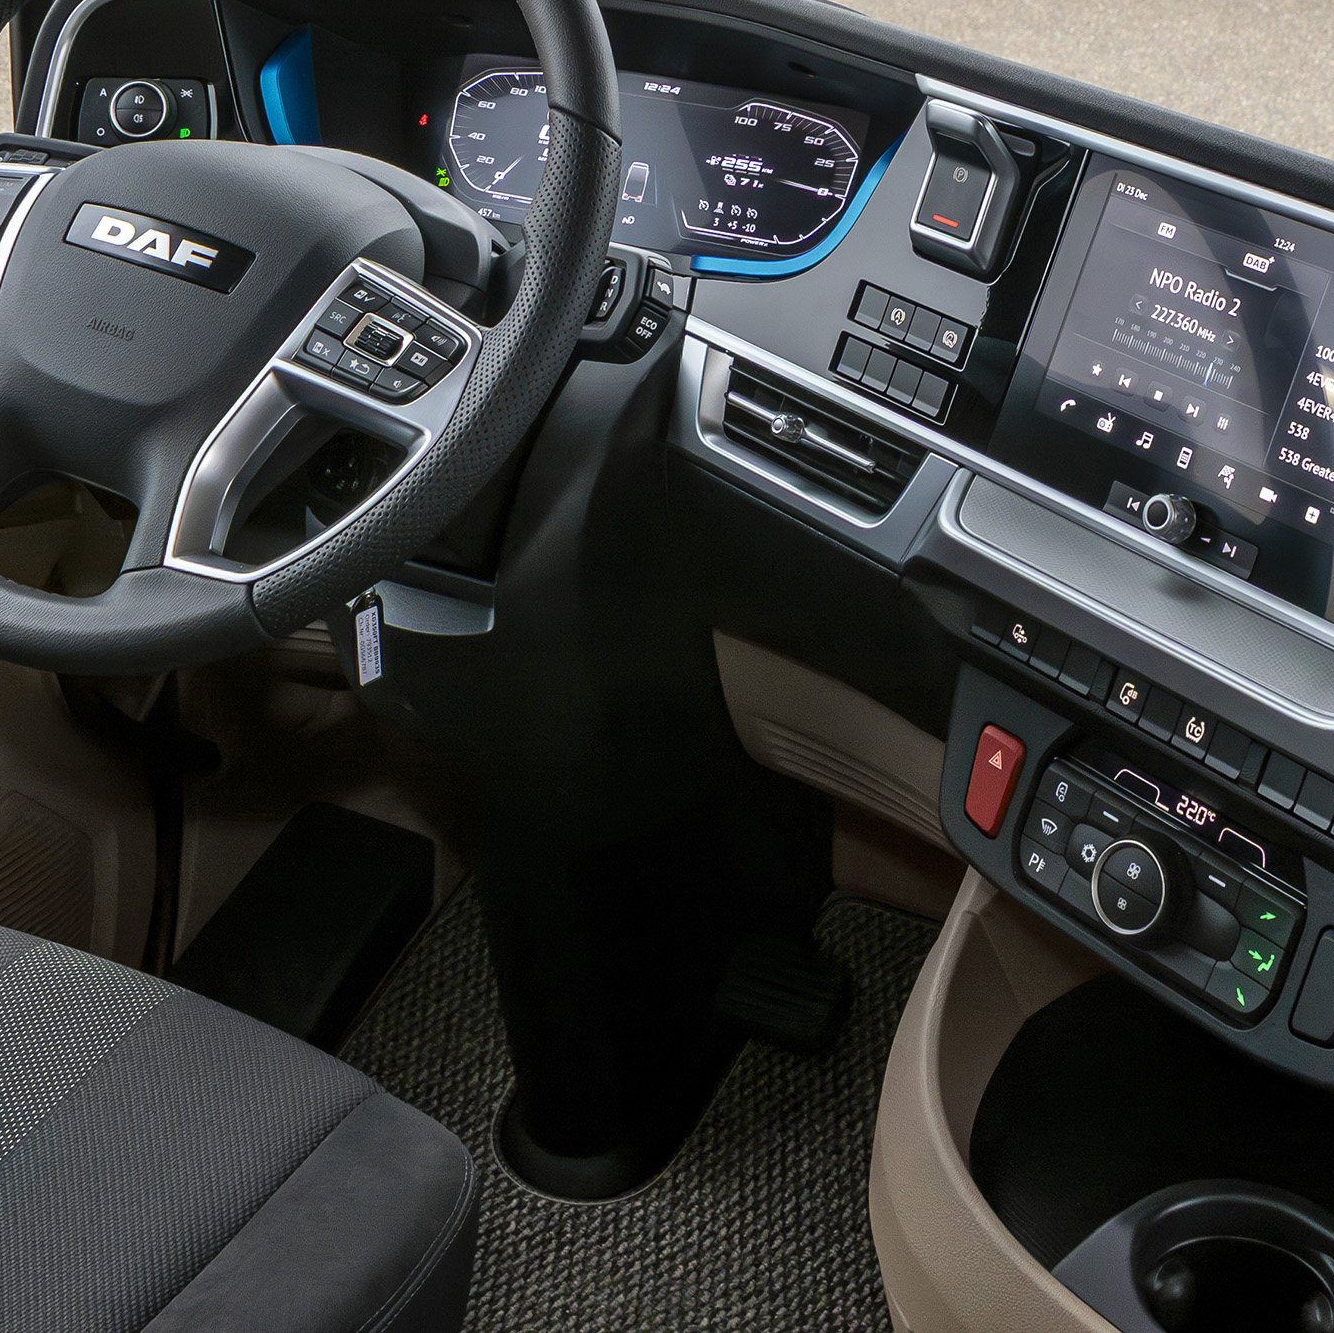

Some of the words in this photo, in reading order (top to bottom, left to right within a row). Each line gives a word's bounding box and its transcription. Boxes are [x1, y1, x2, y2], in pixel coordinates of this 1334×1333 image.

[99, 87, 108, 97] A
[509, 87, 528, 97] 80
[643, 82, 681, 95] 12:24
[477, 100, 496, 110] 60
[734, 116, 758, 127] 100
[773, 122, 793, 132] 75
[468, 132, 486, 141] 40
[803, 136, 825, 146] 50
[476, 155, 495, 165] 20
[721, 156, 763, 173] 255
[814, 158, 836, 168] 25
[1125, 185, 1136, 197] 23
[1134, 188, 1149, 201] Dec
[477, 207, 493, 218] 457
[90, 215, 219, 268] DAF
[1273, 237, 1296, 253] 12:24
[610, 275, 619, 284] D
[605, 288, 614, 298] N
[1149, 267, 1184, 294] NPO
[1184, 281, 1227, 311] Radio
[1227, 298, 1242, 317] 2
[599, 301, 608, 311] R
[329, 311, 348, 324] SRC
[1114, 317, 1125, 326] 170
[640, 316, 658, 330] ECO
[1130, 323, 1141, 332] 180
[1150, 304, 1199, 334] 227.360
[1196, 326, 1217, 343] MHz
[86, 317, 136, 342] AIRBAG
[635, 326, 653, 340] OFF
[1146, 329, 1158, 339] 190
[1162, 336, 1174, 346] 200
[1179, 343, 1191, 352] 210
[1195, 349, 1207, 359] 220
[1212, 356, 1224, 366] 230
[1229, 363, 1242, 374] 240
[1287, 421, 1310, 441] 538
[1278, 447, 1301, 467] 538
[1189, 722, 1202, 737] TC
